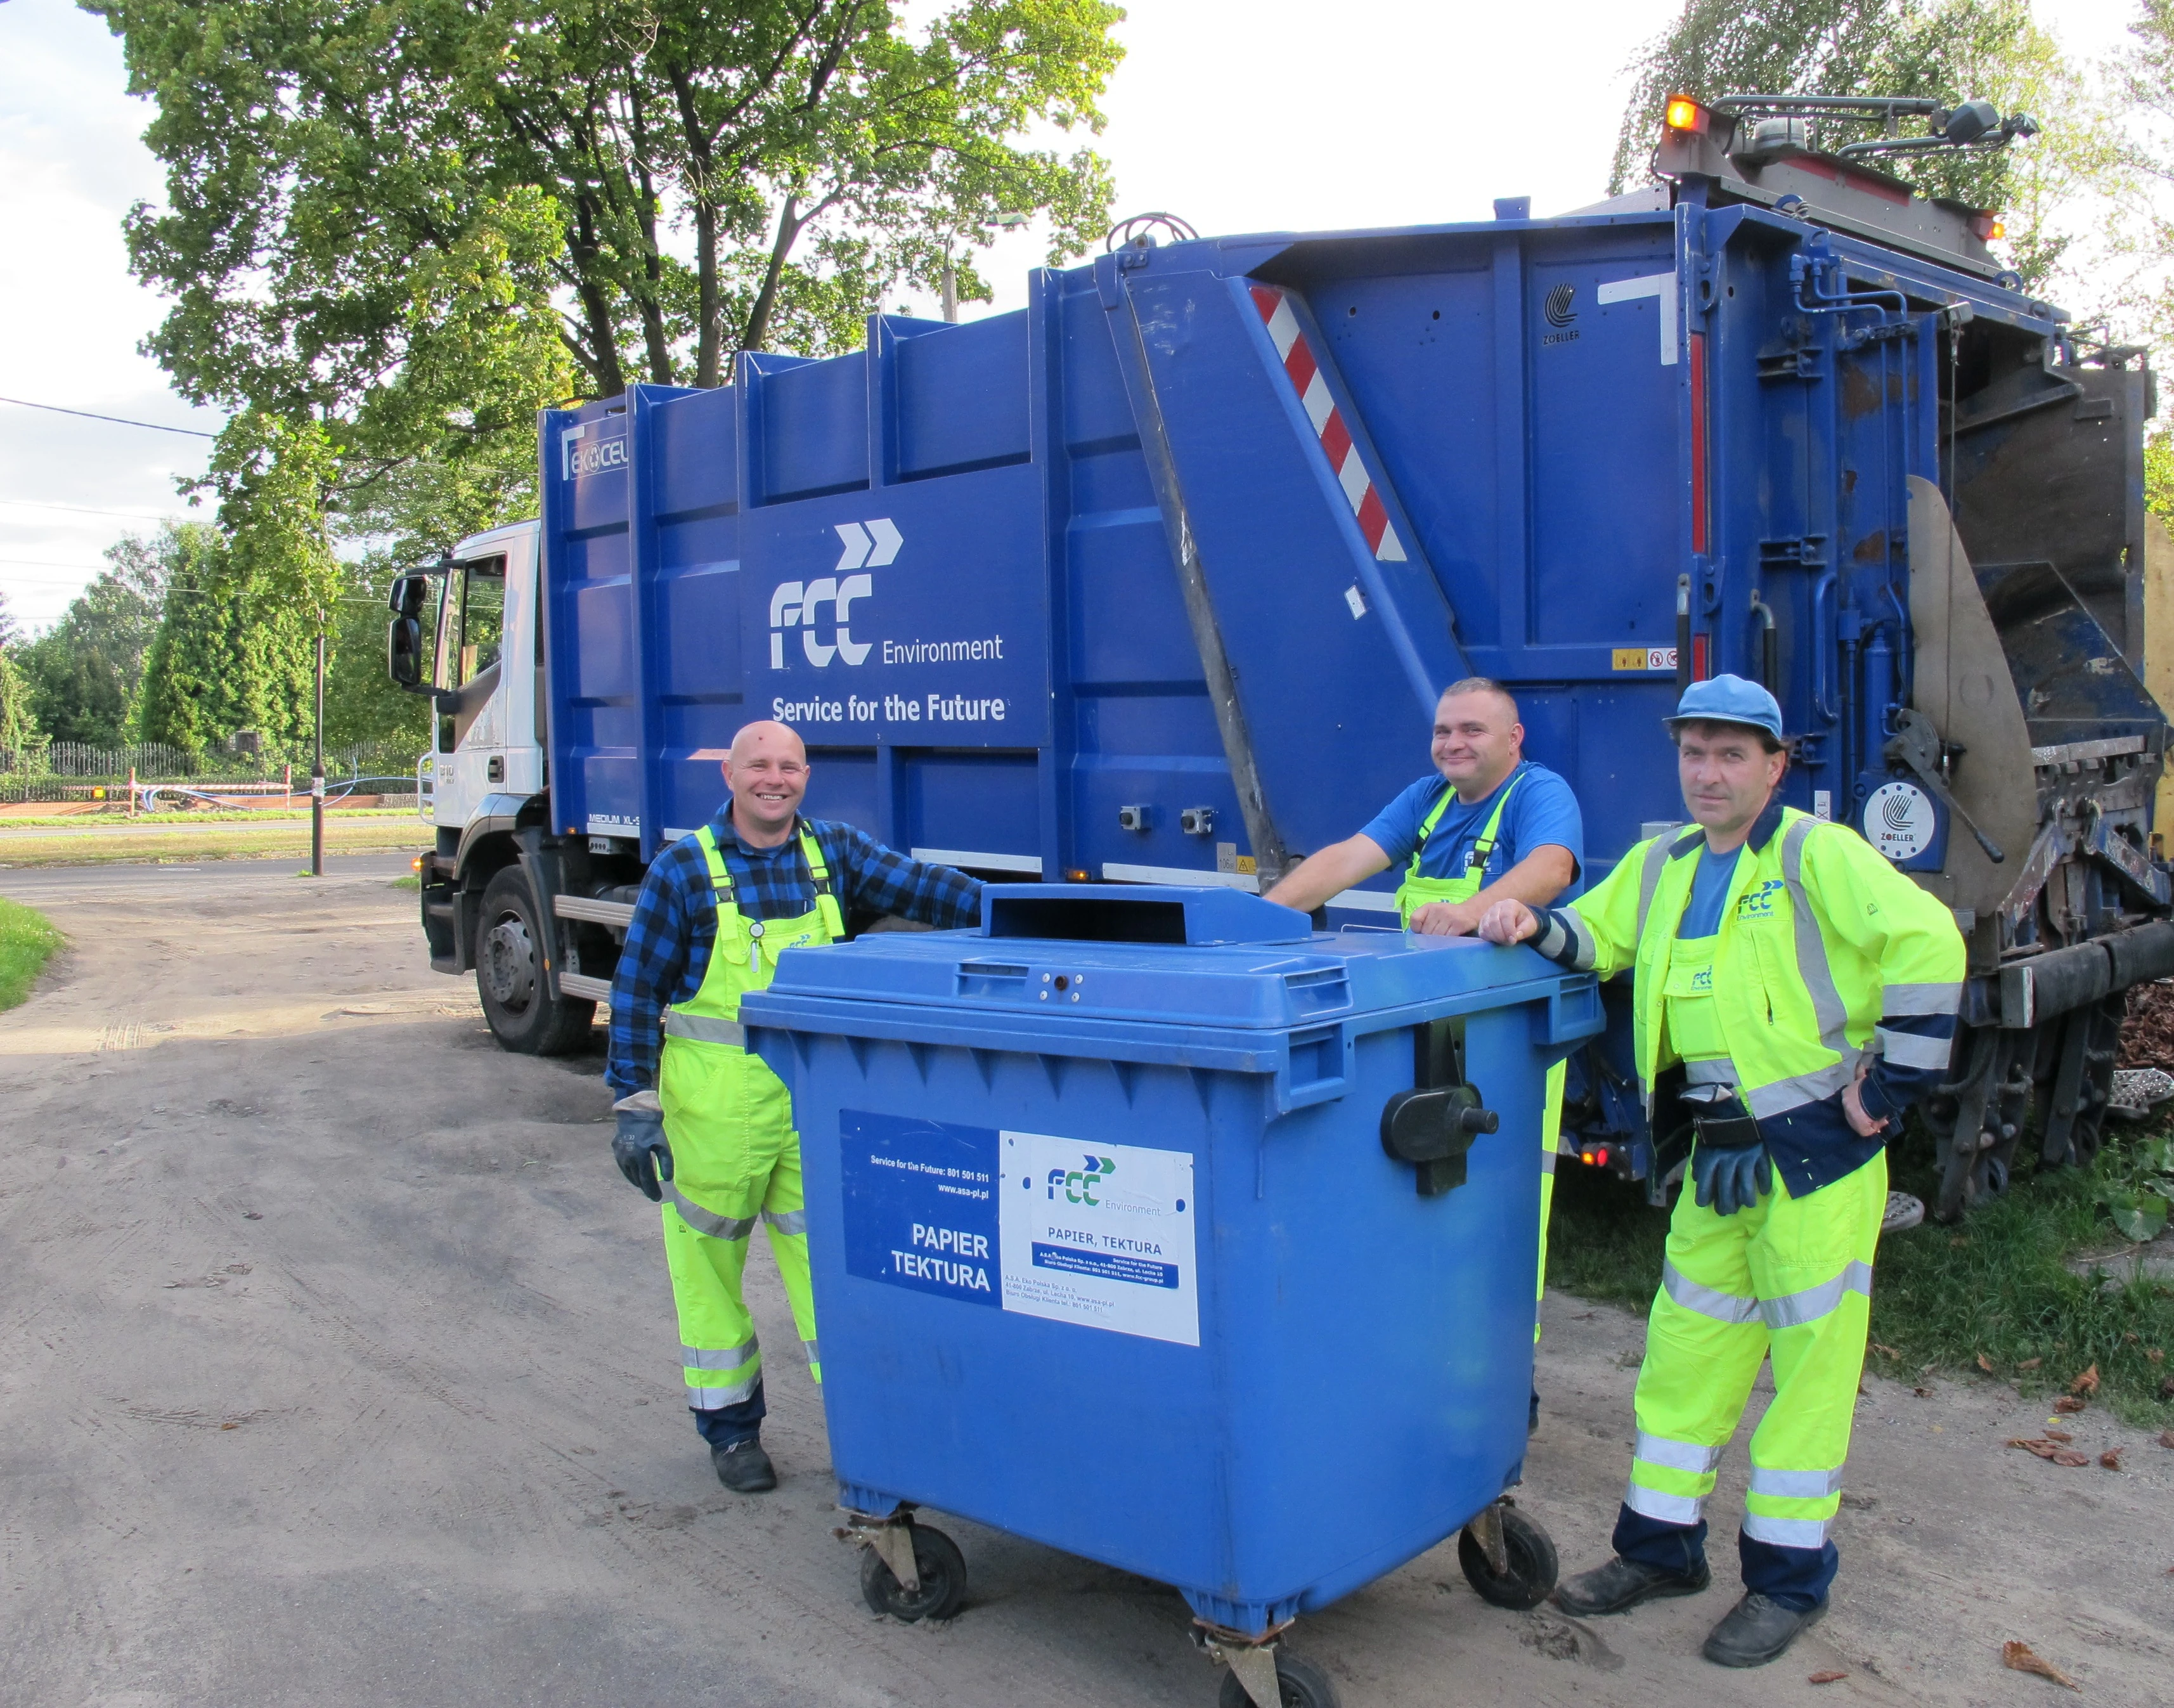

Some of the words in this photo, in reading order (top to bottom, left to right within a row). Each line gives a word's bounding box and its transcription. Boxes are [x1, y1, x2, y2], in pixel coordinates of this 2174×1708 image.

[1543, 330, 1579, 346] ZOELLER
[770, 574, 873, 669] FCC
[883, 635, 1003, 664] Environment
[772, 695, 843, 721] Service
[848, 695, 878, 721] for
[885, 694, 920, 721] the
[928, 694, 1005, 721] Future
[589, 814, 620, 824] MEDIUM
[1880, 832, 1915, 842] ZOELLER
[1737, 891, 1772, 914] FCC
[1737, 911, 1774, 921] Environment
[870, 1155, 895, 1167] Service
[896, 1159, 907, 1169] for
[908, 1161, 919, 1172] the
[921, 1163, 945, 1175] Future:
[947, 1168, 960, 1178] 801
[962, 1170, 974, 1181] 501
[977, 1173, 989, 1182] 511
[938, 1184, 989, 1200] www.asa-pl.pl
[1048, 1168, 1101, 1207] FCC
[1105, 1200, 1161, 1216] Environment
[913, 1223, 989, 1259] PAPIER
[1048, 1227, 1097, 1248] PAPIER,
[1102, 1236, 1161, 1255] TEKTURA
[891, 1250, 991, 1291] TEKTURA
